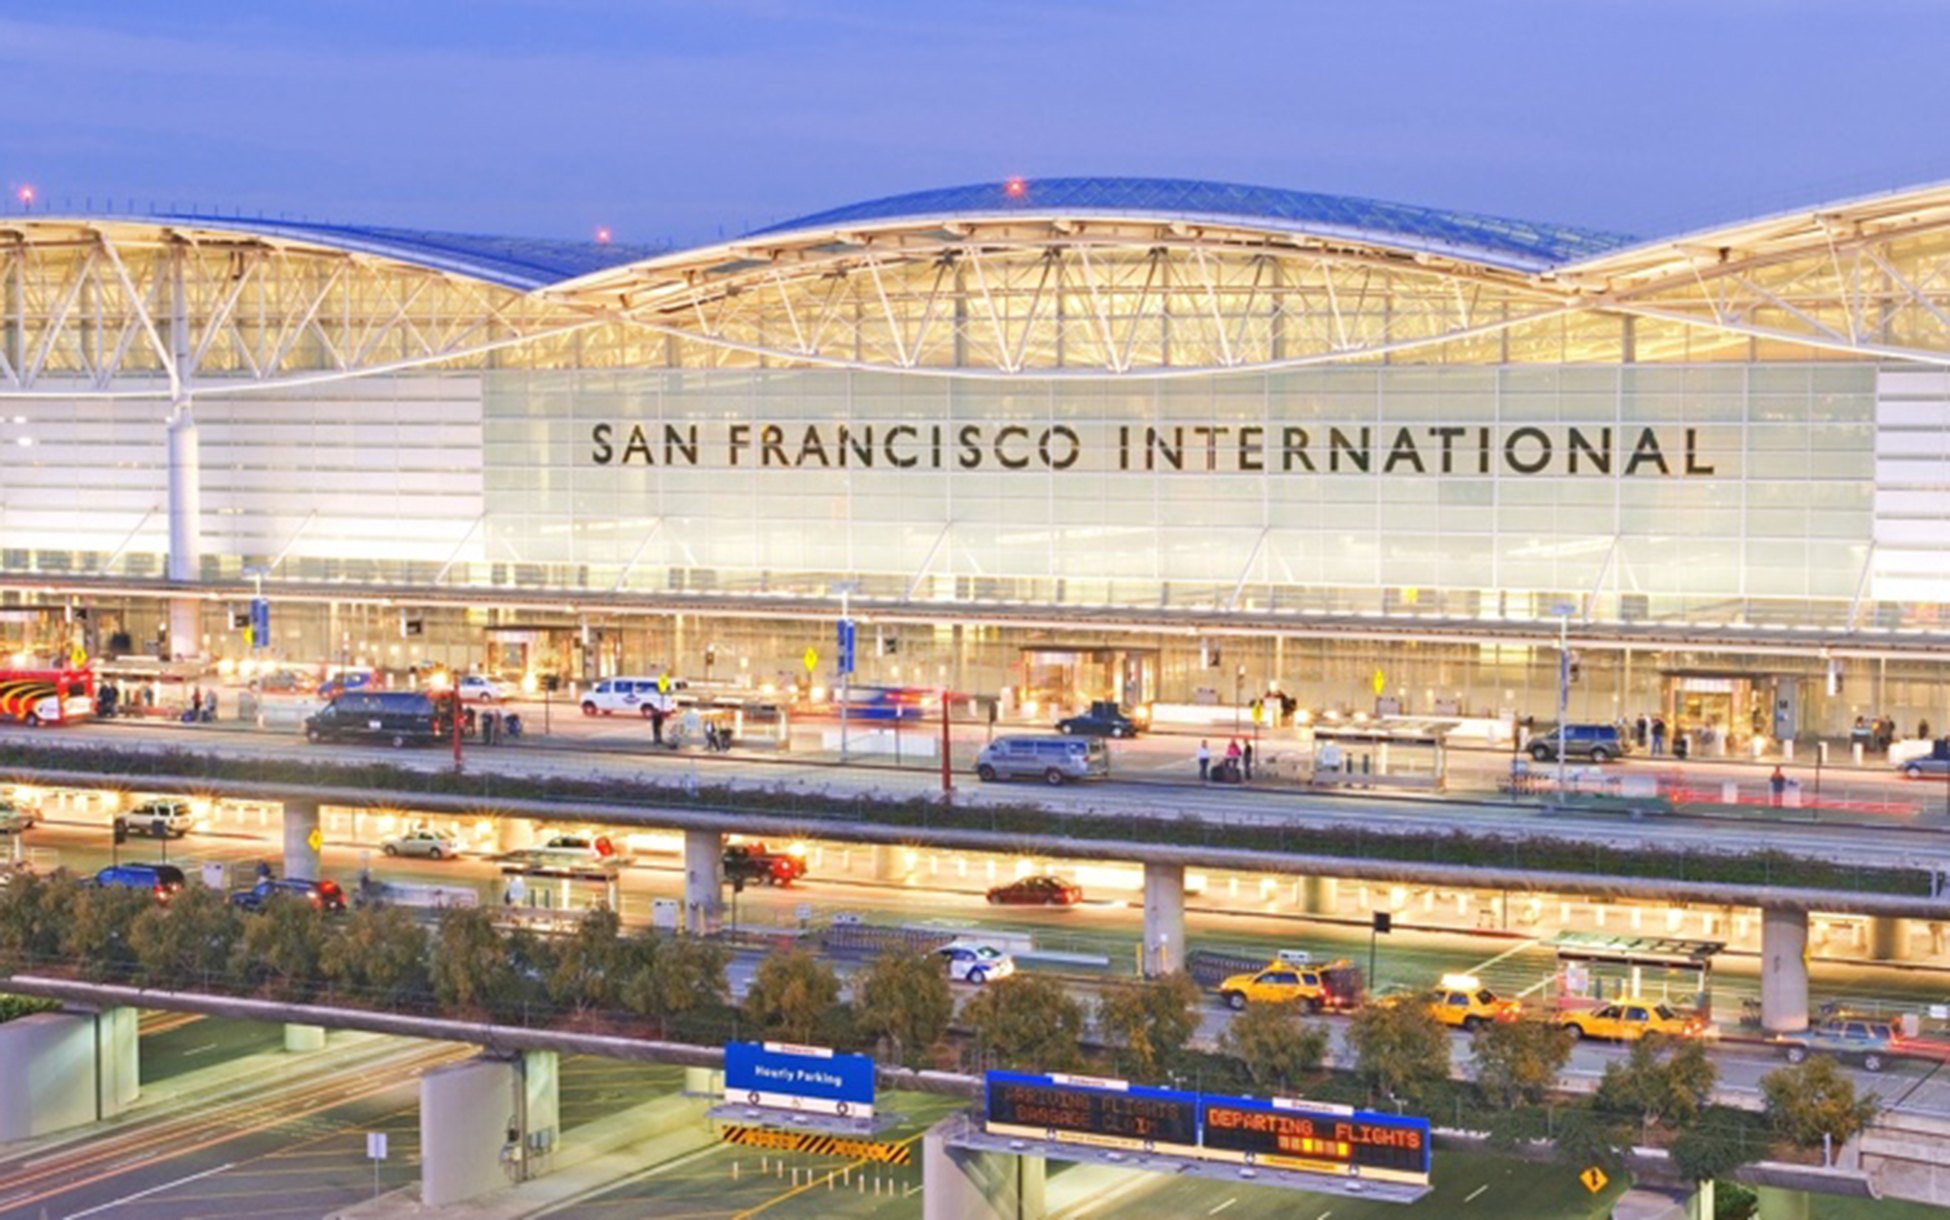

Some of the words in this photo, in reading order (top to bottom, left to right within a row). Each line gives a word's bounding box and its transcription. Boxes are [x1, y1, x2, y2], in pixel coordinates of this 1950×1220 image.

[592, 423, 698, 466] SAN
[730, 424, 1080, 470] FRANCISCO
[1119, 426, 1714, 476] INTERNATIONAL
[755, 1065, 794, 1082] Hourly
[797, 1070, 843, 1088] Parking
[1004, 1086, 1091, 1110] ARRIVING
[1101, 1095, 1179, 1120] FLIGHTS
[1015, 1104, 1090, 1128] BAGGAGE
[1208, 1107, 1314, 1137] DEPARTING
[1335, 1122, 1421, 1149] FLIGHTS
